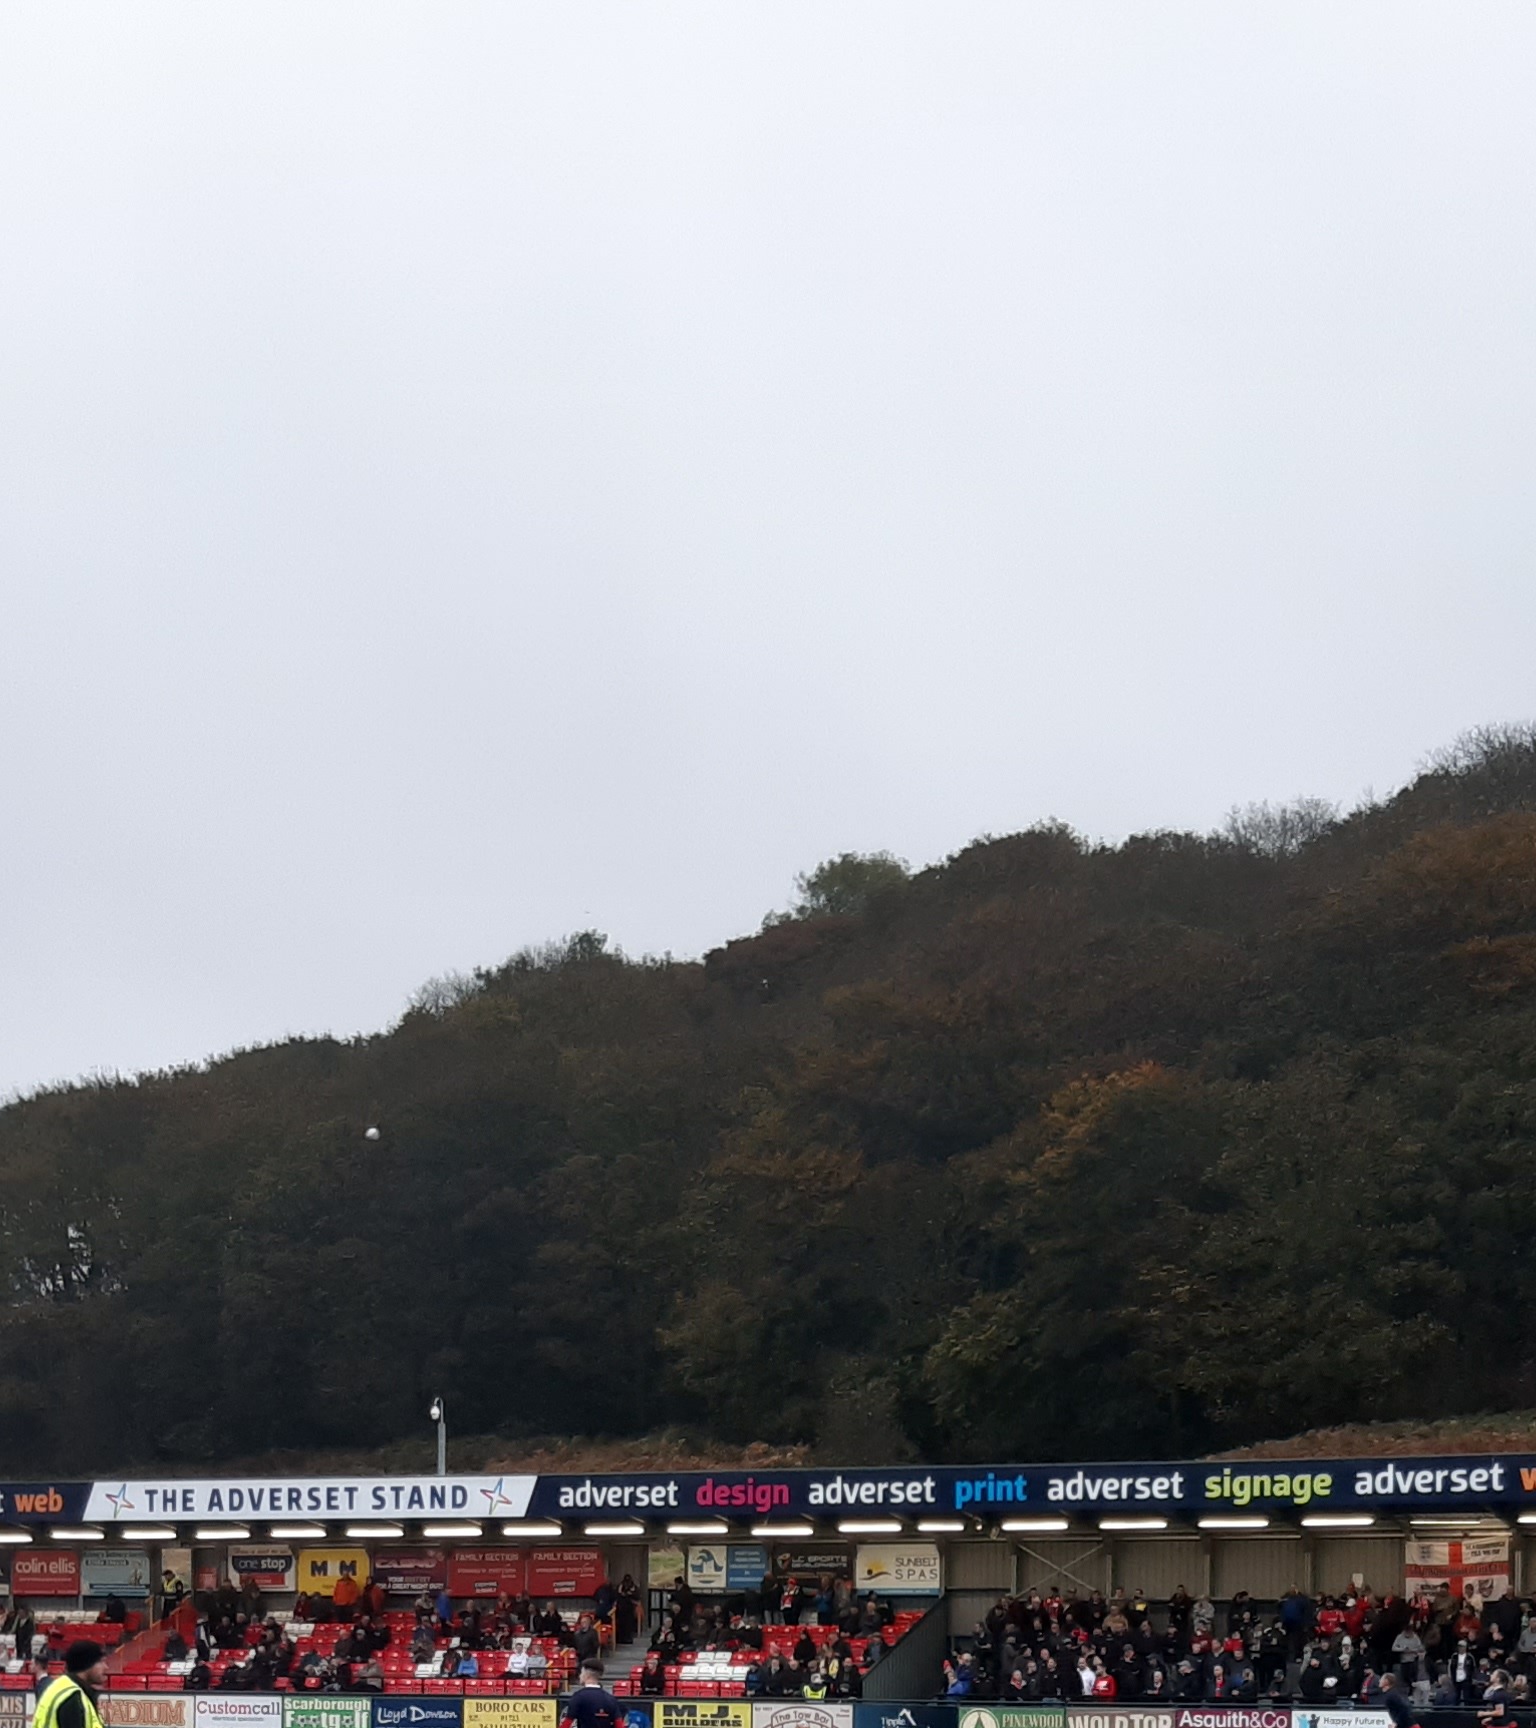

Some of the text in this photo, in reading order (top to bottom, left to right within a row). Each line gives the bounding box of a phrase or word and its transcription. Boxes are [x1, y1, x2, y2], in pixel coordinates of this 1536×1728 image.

[559, 1480, 678, 1508] adverset
[696, 1478, 790, 1512] design
[808, 1476, 936, 1504] adverset
[955, 1472, 1027, 1509] print
[1047, 1471, 1184, 1501] adverset
[1204, 1468, 1333, 1506] signage
[1354, 1463, 1505, 1496] adverset
[14, 1487, 63, 1513] web
[145, 1485, 469, 1512] THE ADVERSET STAND
[455, 1552, 519, 1562] FAMILY SECTION
[533, 1551, 598, 1561] FAMILY SECTION
[895, 1556, 938, 1567] SUNBELT
[15, 1557, 48, 1574] colin
[49, 1558, 76, 1575] ellis
[260, 1557, 286, 1572] stop
[895, 1568, 938, 1580] SPAS
[196, 1700, 281, 1716] Customcall
[284, 1697, 371, 1712] Scarborough
[475, 1701, 546, 1713] BORO CARS
[377, 1706, 408, 1724] Lloyd
[662, 1718, 743, 1727] BUILDERS
[774, 1713, 791, 1724] The
[792, 1710, 812, 1720] Tow
[813, 1712, 830, 1725] Bar
[1002, 1713, 1063, 1728] PINEWOOD
[1323, 1716, 1386, 1727] Happy Futures
